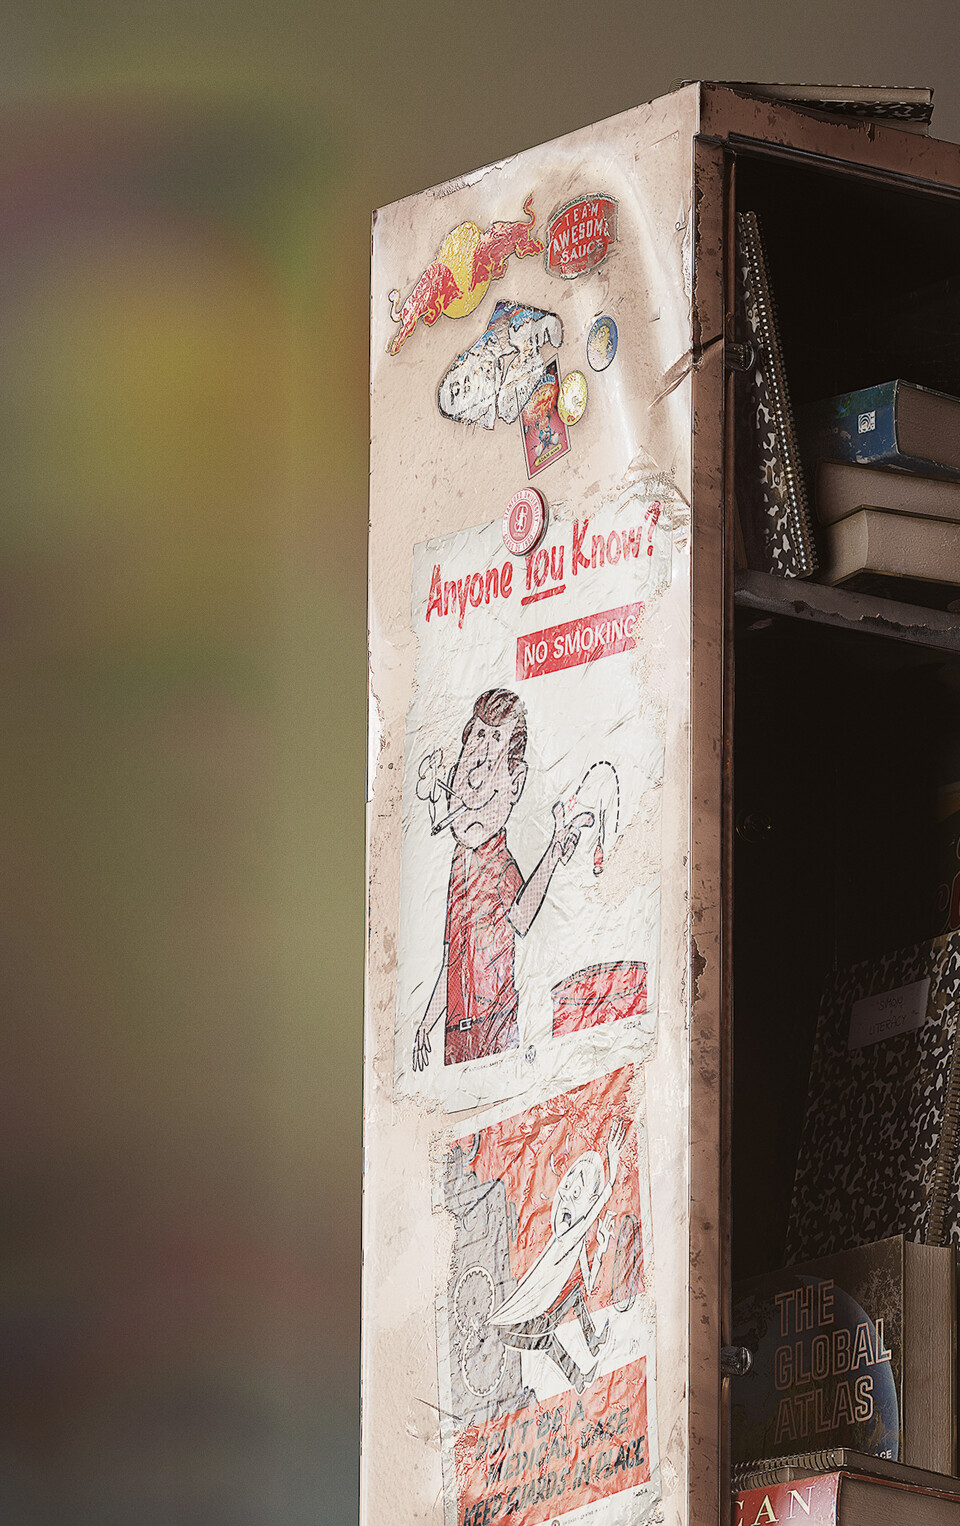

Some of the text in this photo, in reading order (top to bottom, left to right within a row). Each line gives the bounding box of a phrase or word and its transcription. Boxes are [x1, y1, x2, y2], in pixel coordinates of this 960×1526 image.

[565, 203, 599, 227] TEAM
[425, 546, 566, 630] Anyone You
[523, 640, 548, 668] NO
[774, 1278, 835, 1338] THE
[773, 1317, 893, 1391] GLOBAL
[475, 1418, 534, 1462] DON'T
[536, 1405, 565, 1441] BE
[773, 1374, 874, 1445] ATLAS
[486, 1407, 630, 1487] MEDICAL CASE
[506, 1469, 571, 1516] GUARDS
[572, 1456, 592, 1491] IN
[595, 1434, 646, 1481] PLACE
